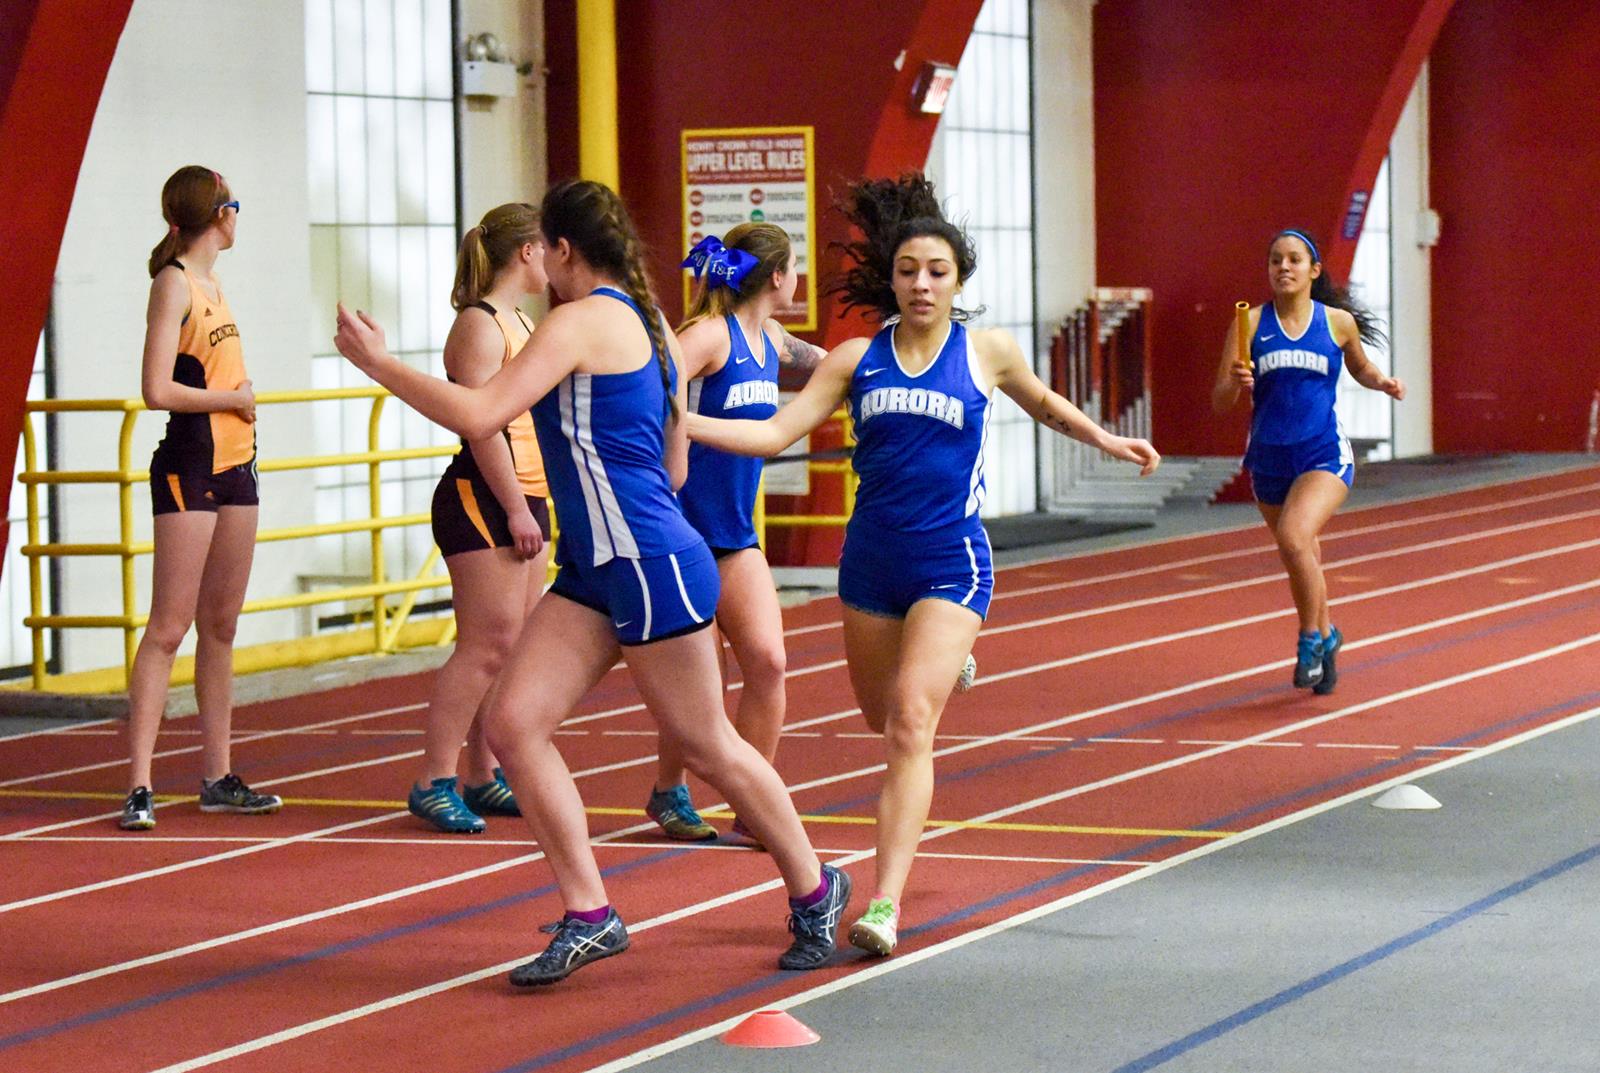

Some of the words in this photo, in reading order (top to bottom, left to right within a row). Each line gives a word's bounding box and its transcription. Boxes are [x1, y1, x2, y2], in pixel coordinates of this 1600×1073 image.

[687, 152, 726, 172] UPPER
[727, 151, 765, 171] LEVEL
[767, 150, 806, 170] RULES
[1258, 348, 1329, 376] AURORA
[861, 386, 964, 430] AURORA
